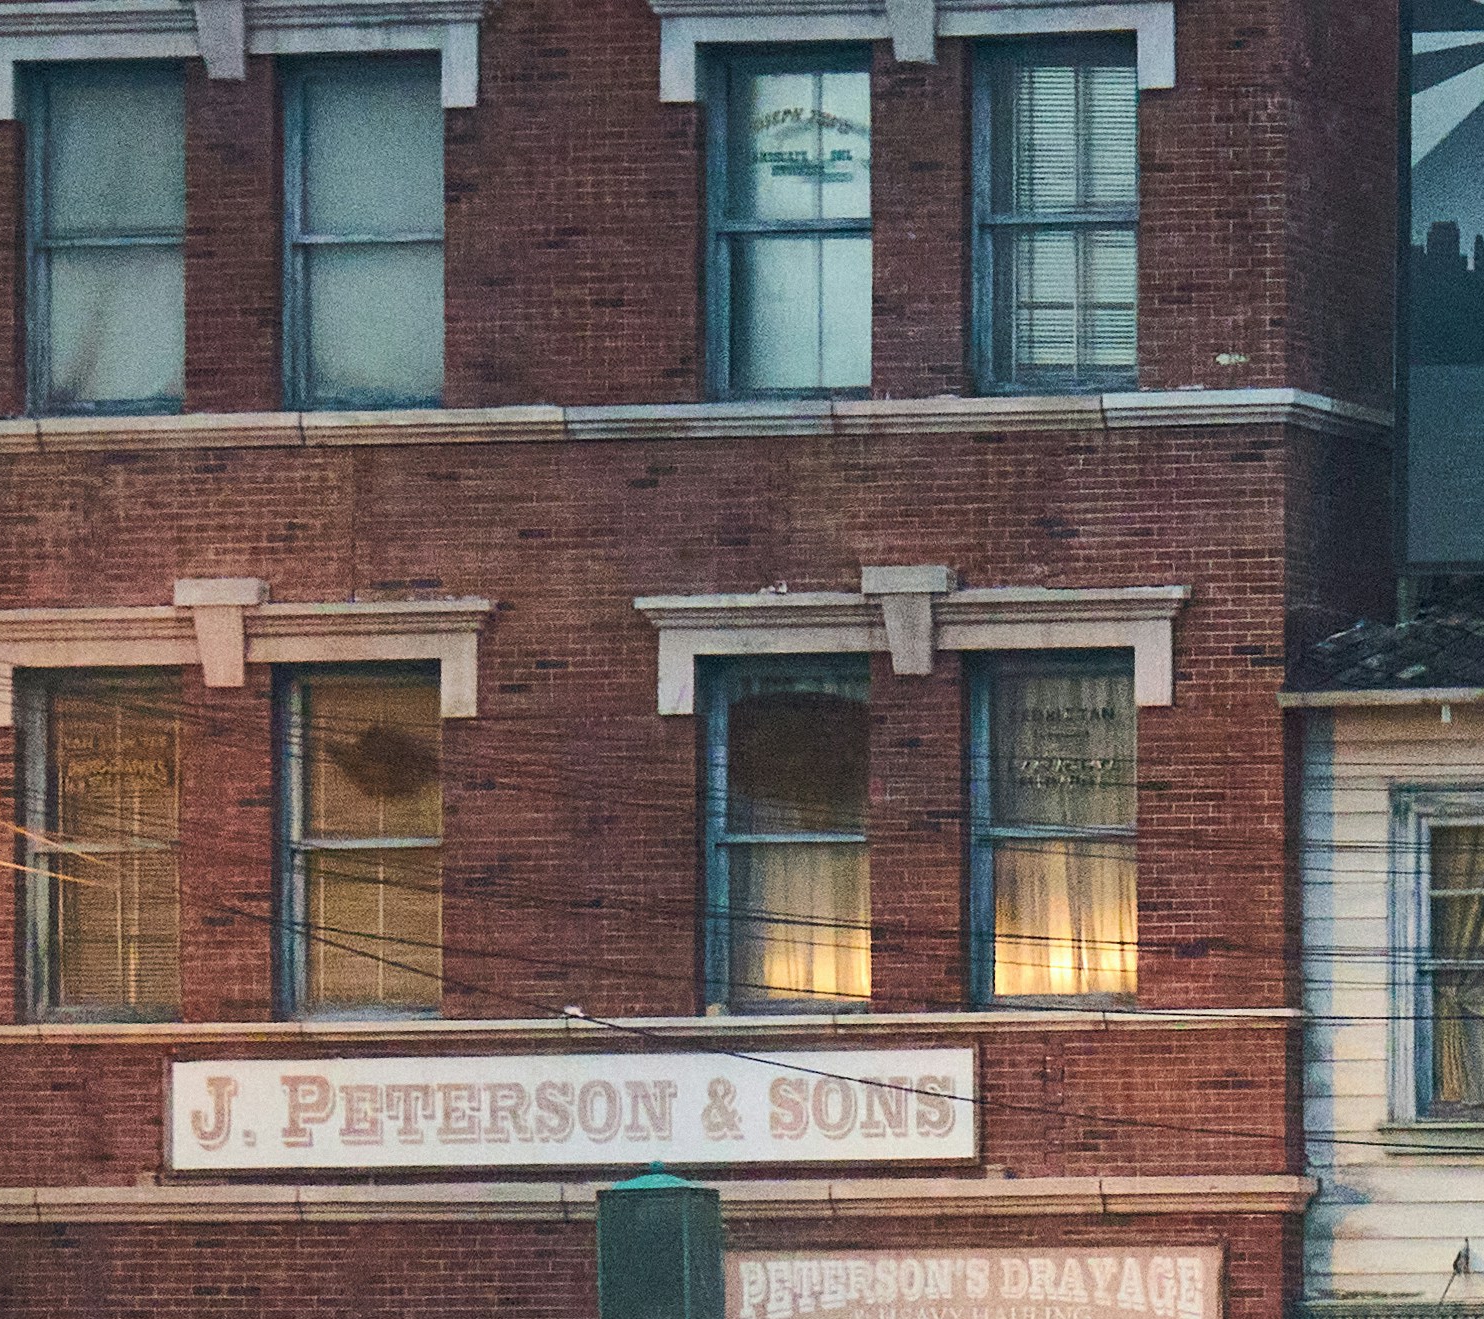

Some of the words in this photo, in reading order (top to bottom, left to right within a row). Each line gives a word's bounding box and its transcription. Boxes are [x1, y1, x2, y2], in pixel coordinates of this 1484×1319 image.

[191, 1076, 257, 1151] J.
[280, 1074, 679, 1148] PETERSON
[700, 1077, 745, 1142] &
[768, 1075, 957, 1141] SONS
